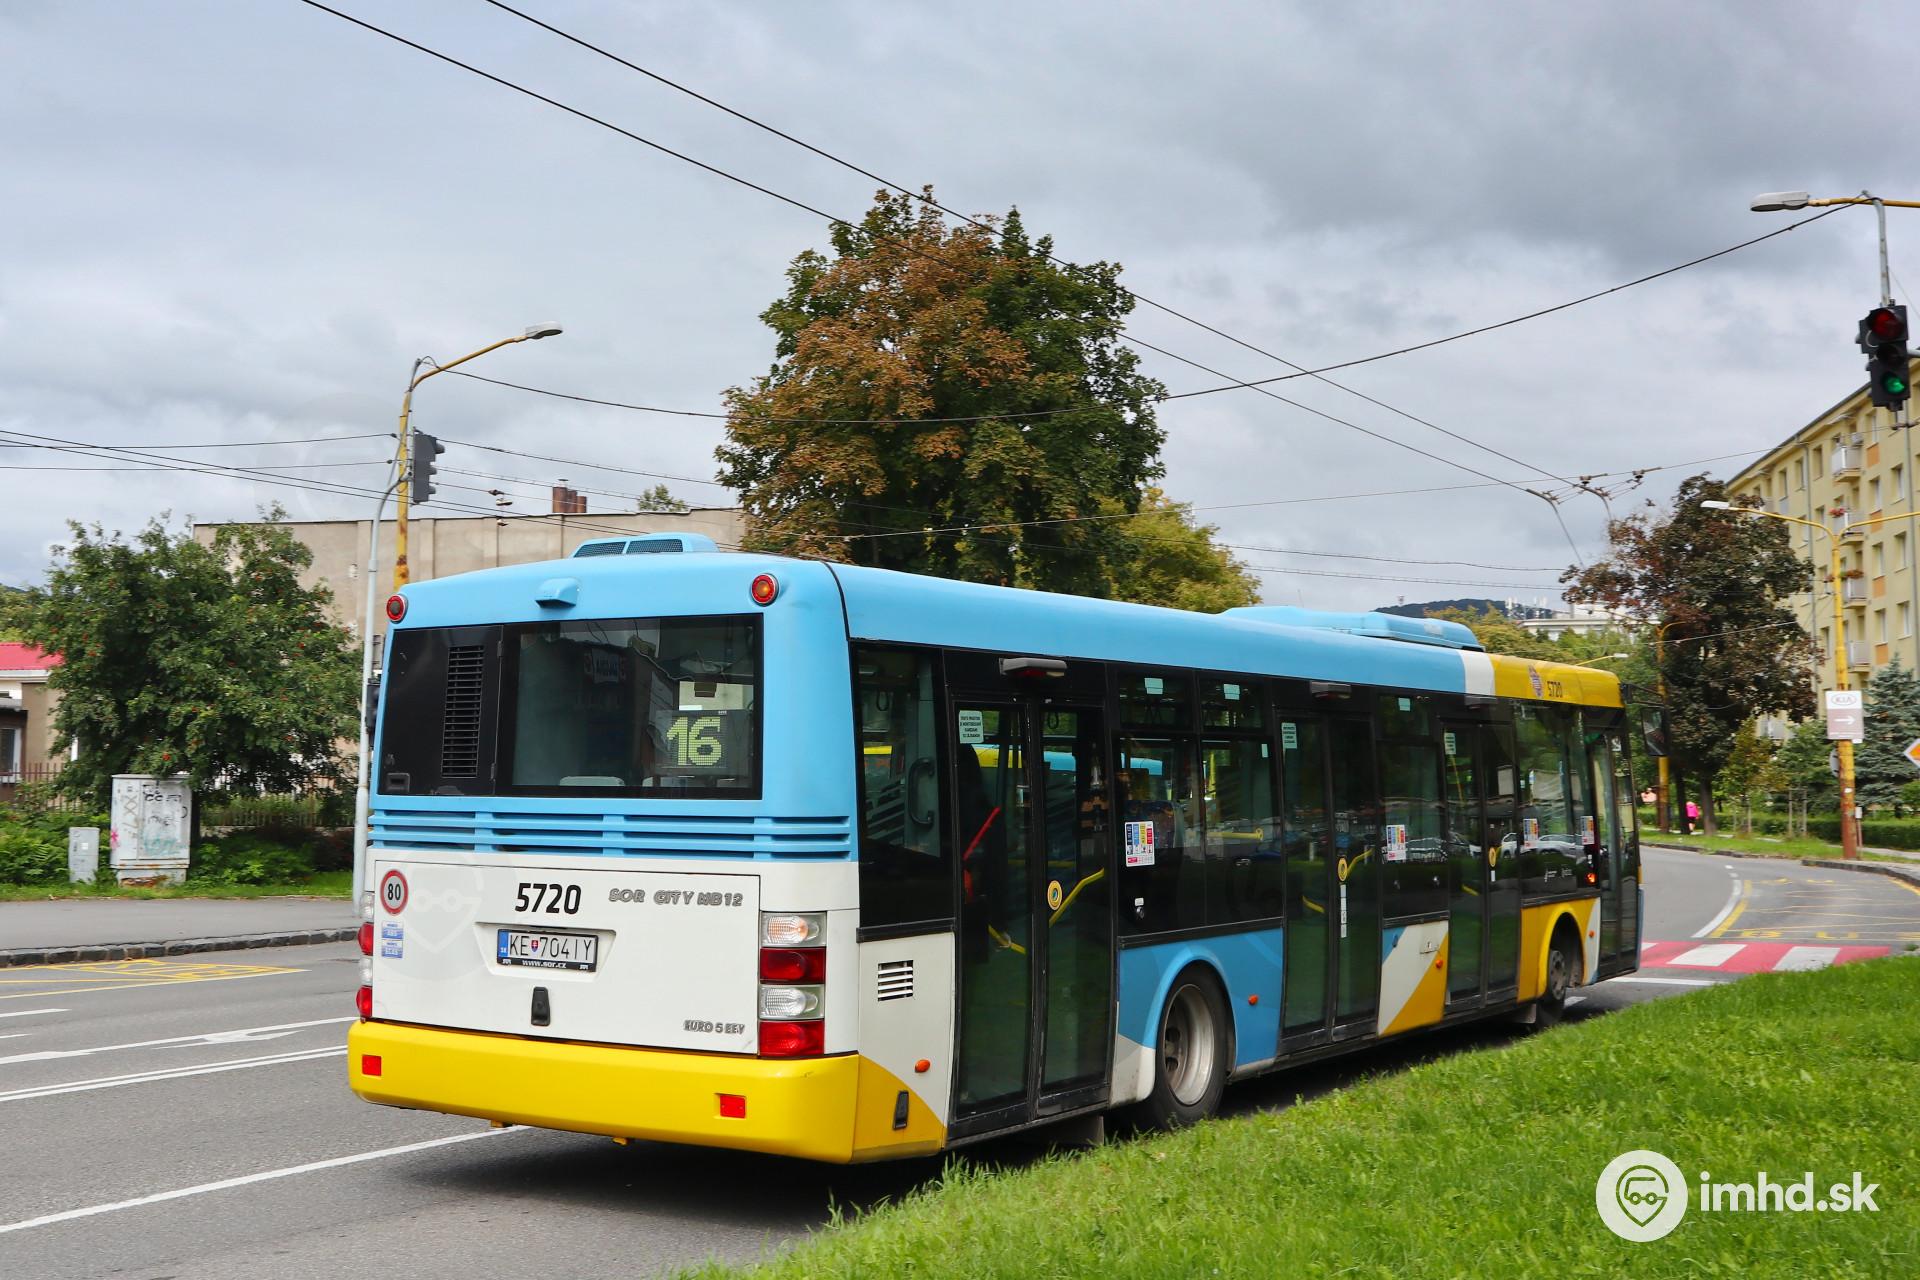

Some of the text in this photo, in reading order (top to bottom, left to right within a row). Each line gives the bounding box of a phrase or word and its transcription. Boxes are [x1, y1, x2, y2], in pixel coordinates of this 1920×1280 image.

[1547, 680, 1563, 698] 5720
[667, 716, 721, 766] 16
[387, 883, 402, 901] 80
[514, 882, 582, 915] 5720
[608, 888, 646, 903] SOR
[653, 889, 694, 905] CITY
[509, 934, 530, 957] KE
[522, 960, 567, 969] www.sor.cz
[683, 1019, 714, 1034] EURO
[715, 1021, 724, 1034] 5
